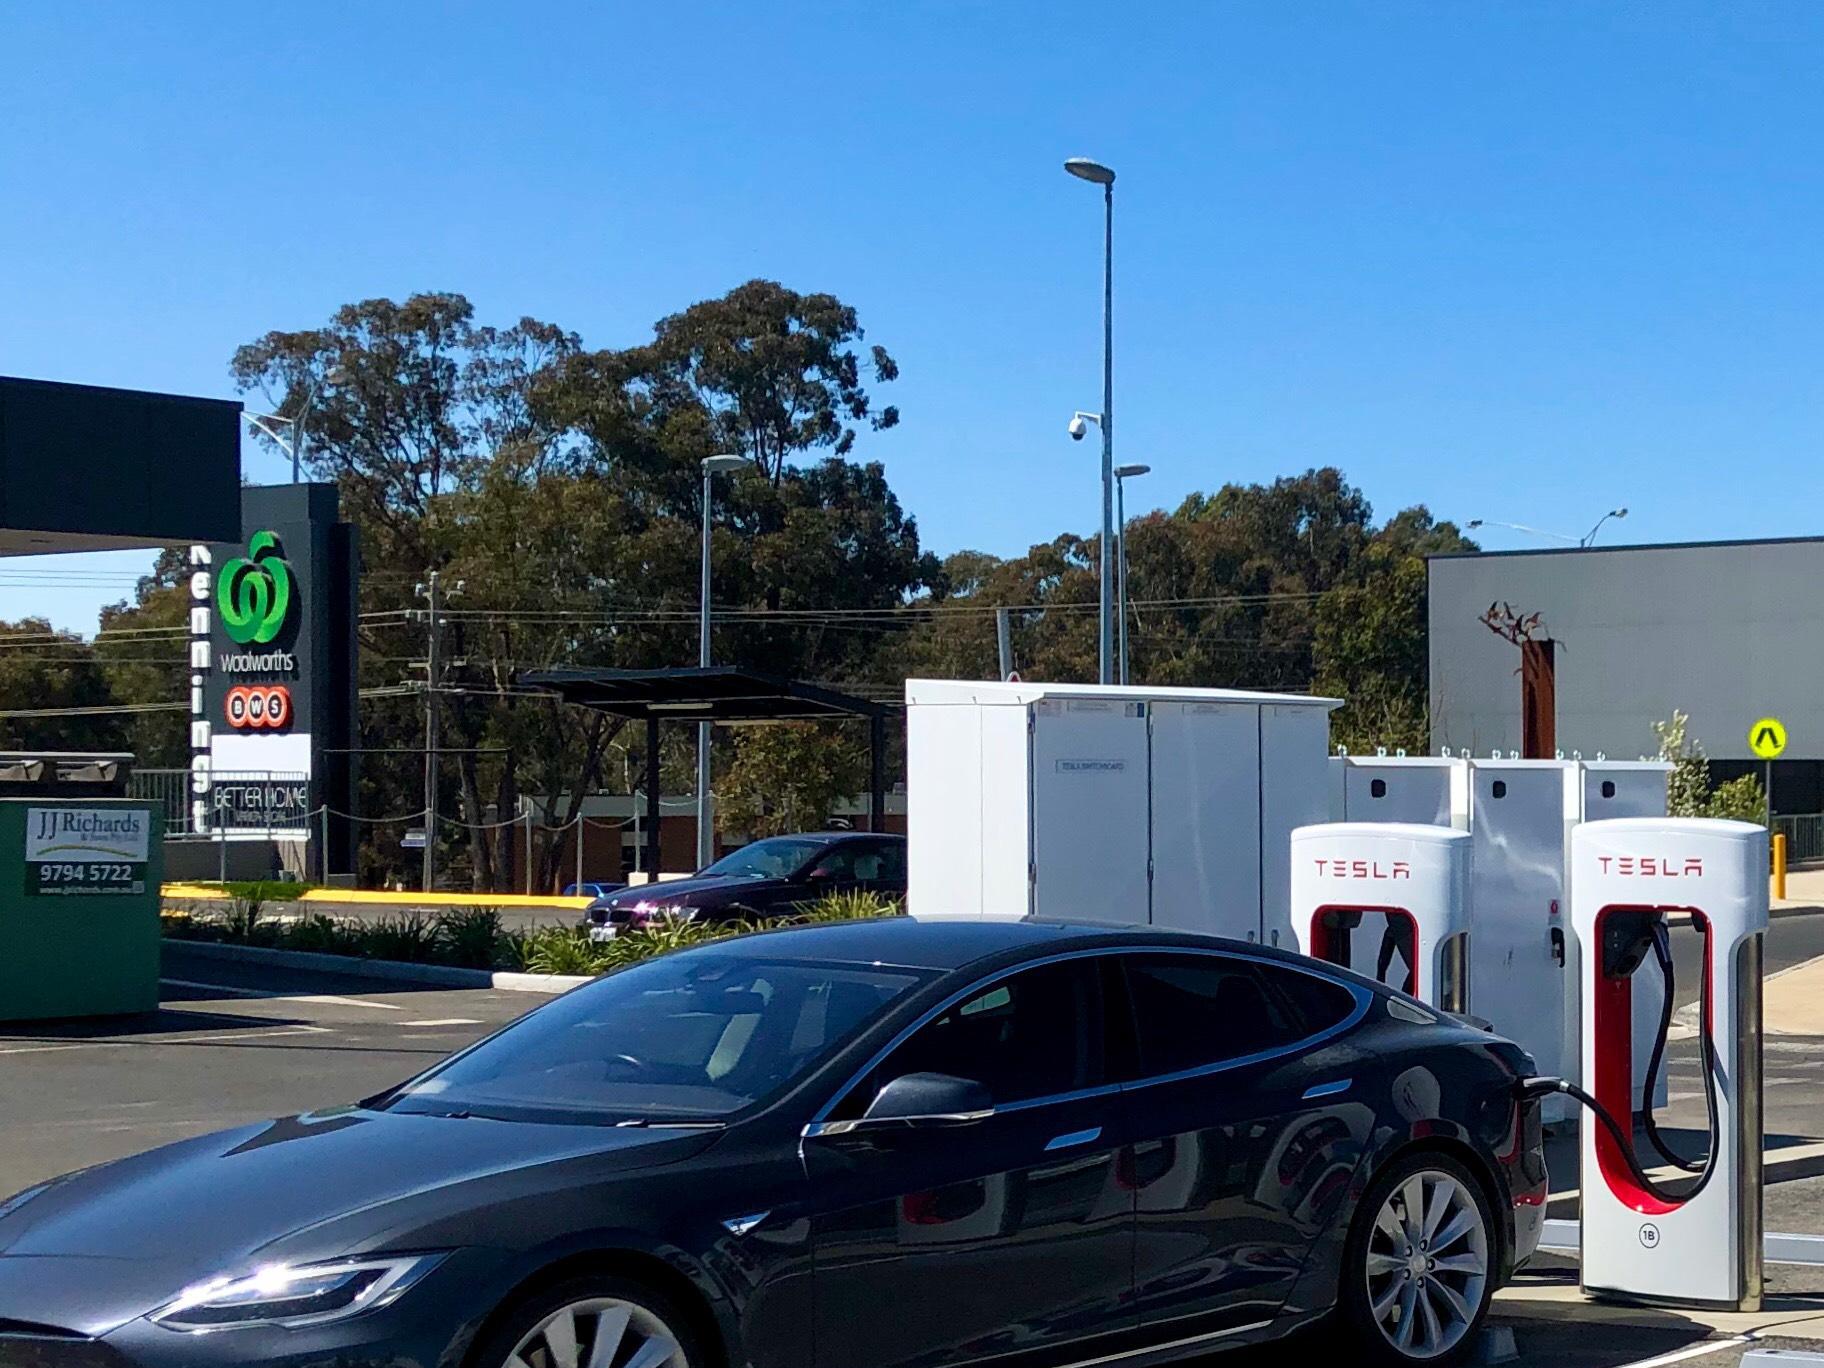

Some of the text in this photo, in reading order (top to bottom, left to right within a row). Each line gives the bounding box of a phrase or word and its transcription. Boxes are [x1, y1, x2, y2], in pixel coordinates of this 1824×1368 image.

[220, 649, 294, 673] Woolworths
[233, 699, 280, 715] BWS
[62, 811, 140, 833] Richards
[40, 864, 132, 881] 9794 5722
[1315, 860, 1409, 879] TESLA
[1598, 857, 1703, 877] TESLA
[1642, 1230, 1655, 1241] 1B
